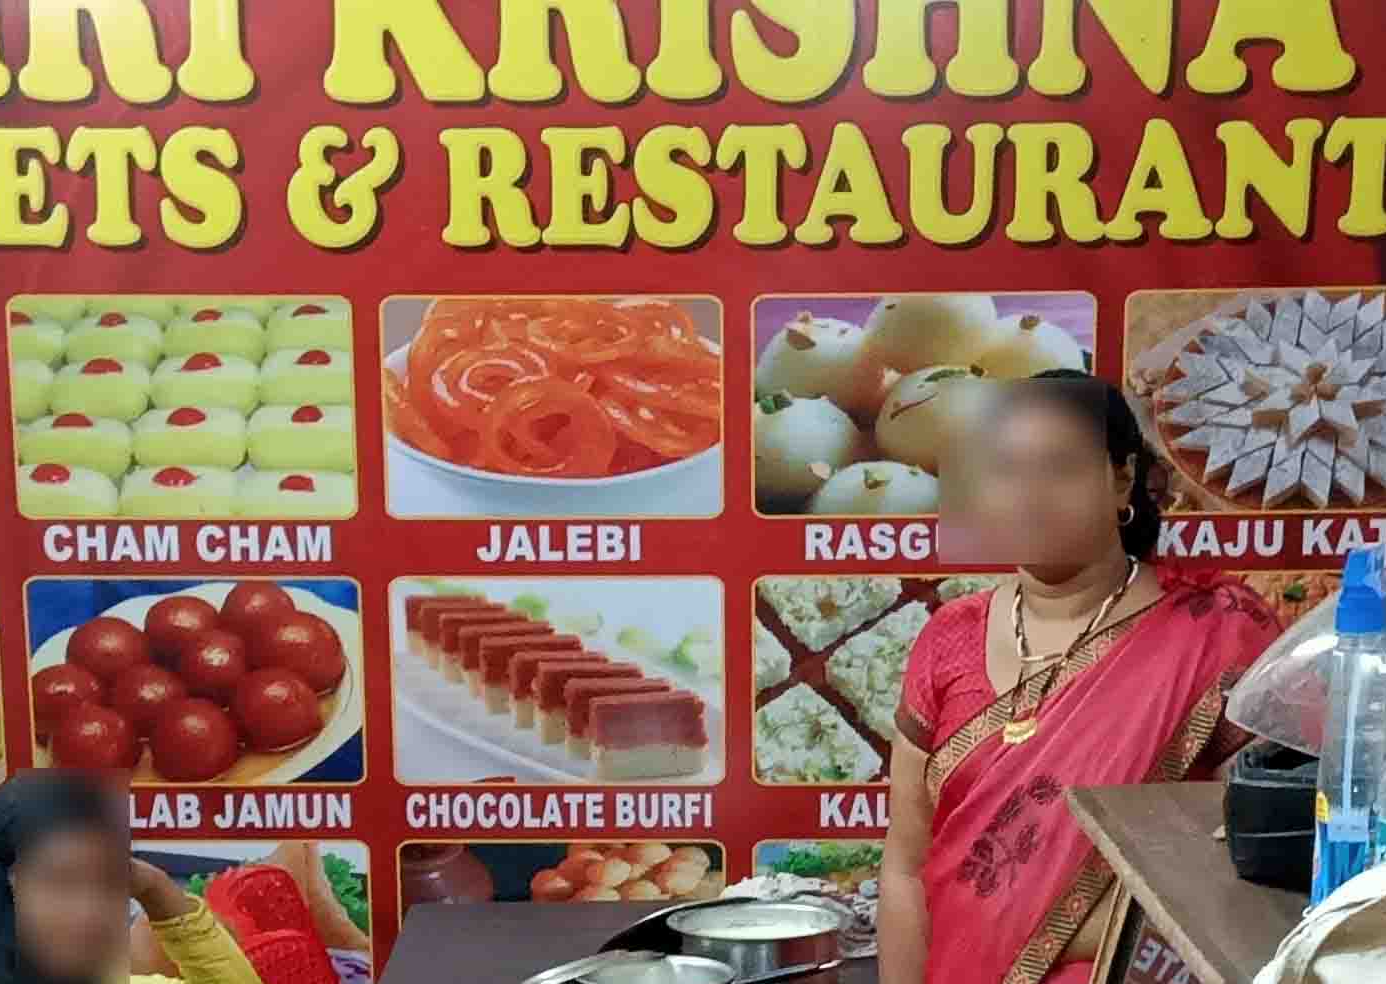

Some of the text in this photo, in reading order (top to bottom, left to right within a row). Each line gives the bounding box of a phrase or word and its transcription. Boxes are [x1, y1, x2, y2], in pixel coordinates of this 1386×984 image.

[287, 124, 401, 250] &
[43, 523, 333, 562] CHAM CHAM
[476, 524, 641, 562] JALEBI
[804, 522, 939, 561] RASG
[1156, 518, 1285, 558] KAJU
[213, 793, 352, 829] JAMUN
[405, 792, 713, 829] CHOCOLATE BURFI
